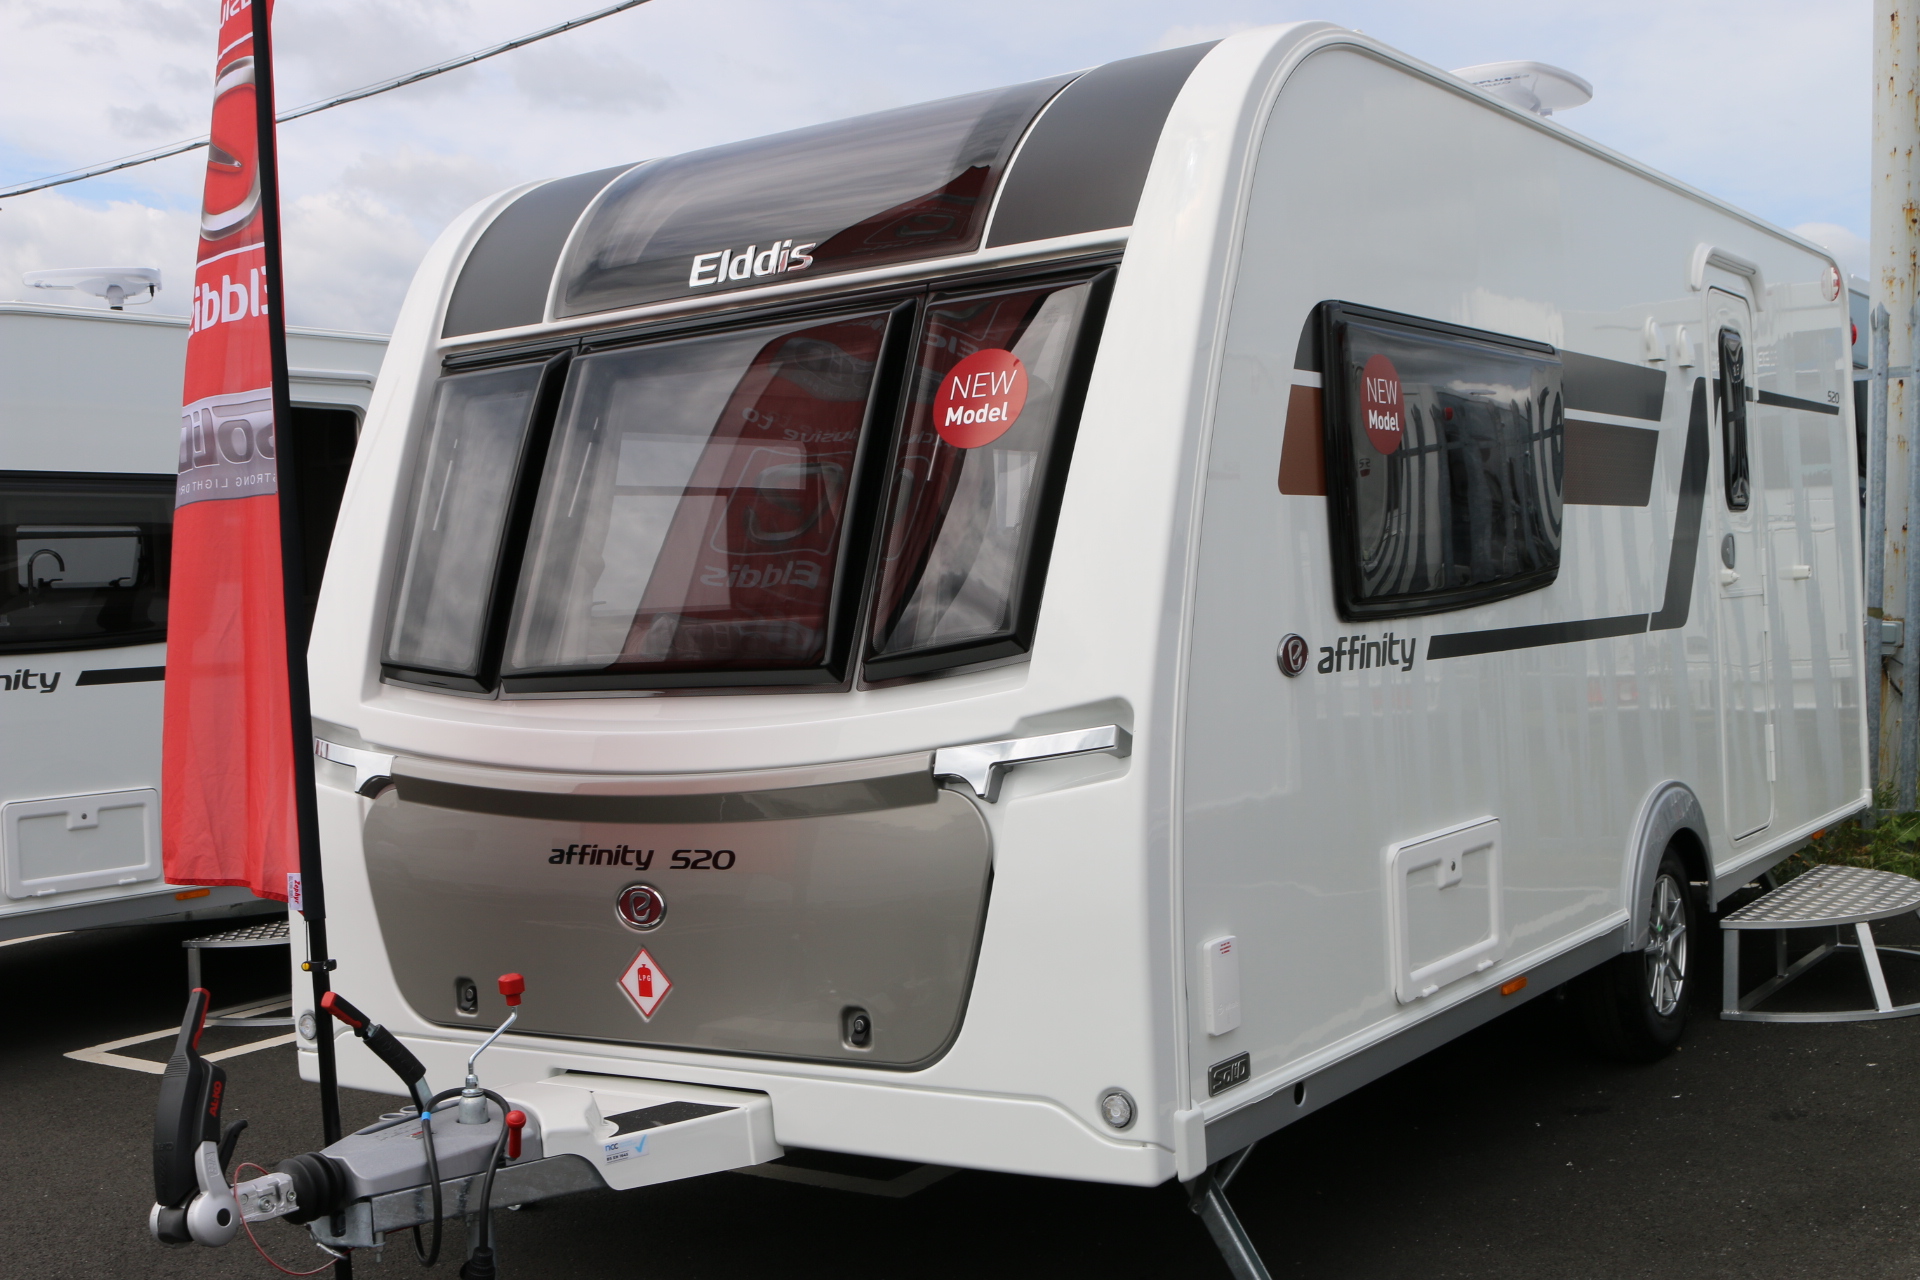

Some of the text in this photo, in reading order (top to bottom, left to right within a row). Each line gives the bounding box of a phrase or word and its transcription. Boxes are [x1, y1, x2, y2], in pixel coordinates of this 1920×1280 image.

[689, 239, 817, 288] Elddis
[950, 369, 1018, 400] NEW
[1366, 377, 1398, 405] NEW
[1827, 390, 1840, 404] 520
[944, 401, 1008, 427] Model
[1368, 409, 1400, 432] Model
[1317, 632, 1416, 674] affinity
[549, 844, 736, 871] affinity 520
[638, 974, 652, 982] LPG
